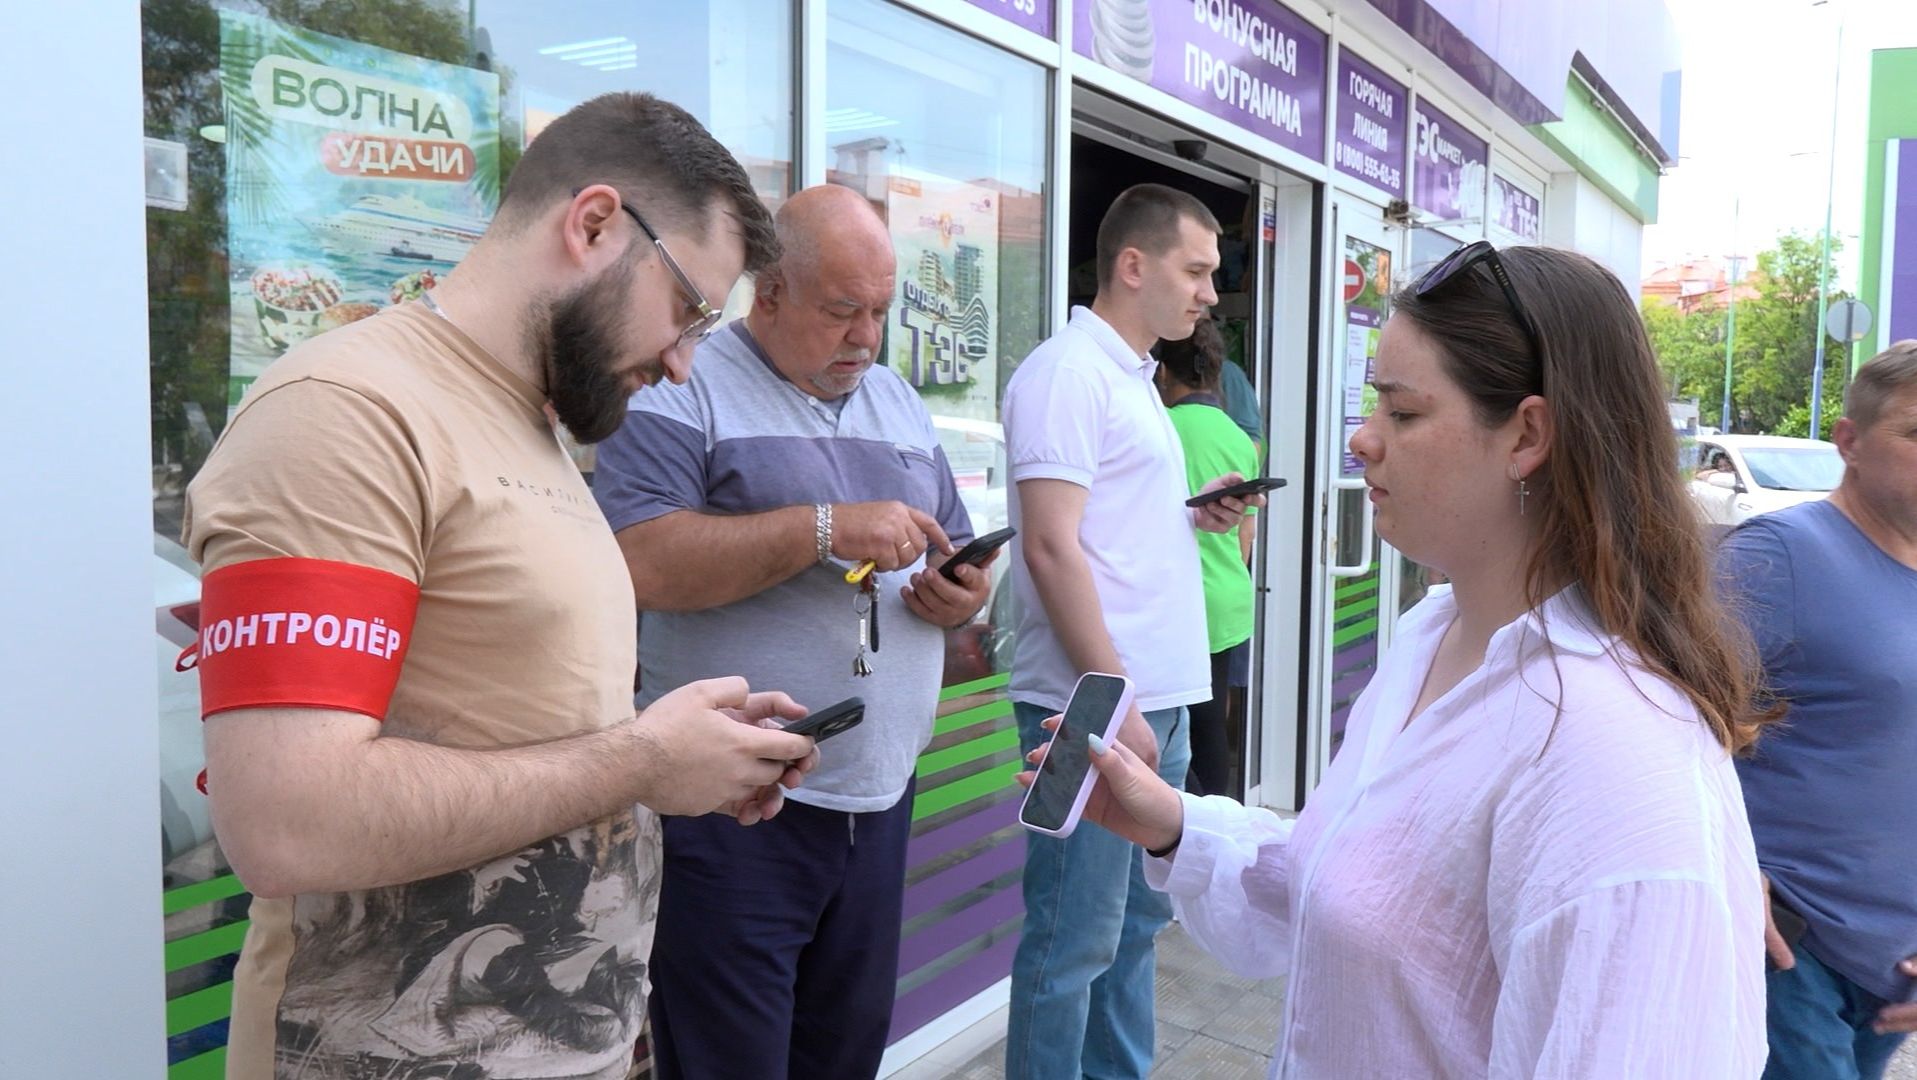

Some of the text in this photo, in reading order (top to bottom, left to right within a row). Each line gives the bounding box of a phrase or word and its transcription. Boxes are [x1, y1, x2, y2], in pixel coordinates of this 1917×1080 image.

[1194, 0, 1297, 76] БОНУСНАЯ
[272, 67, 454, 139] ВОЛНА
[1185, 41, 1302, 137] ПРОГРАММА
[1350, 71, 1393, 119] ГОРЯЧАЯ
[1336, 141, 1342, 163] 8
[1352, 111, 1388, 153] ЛИНИЯ
[335, 138, 466, 176] УДАЧИ
[901, 306, 968, 386] ТЭС
[202, 612, 401, 660] КОНТРОЛЁР
